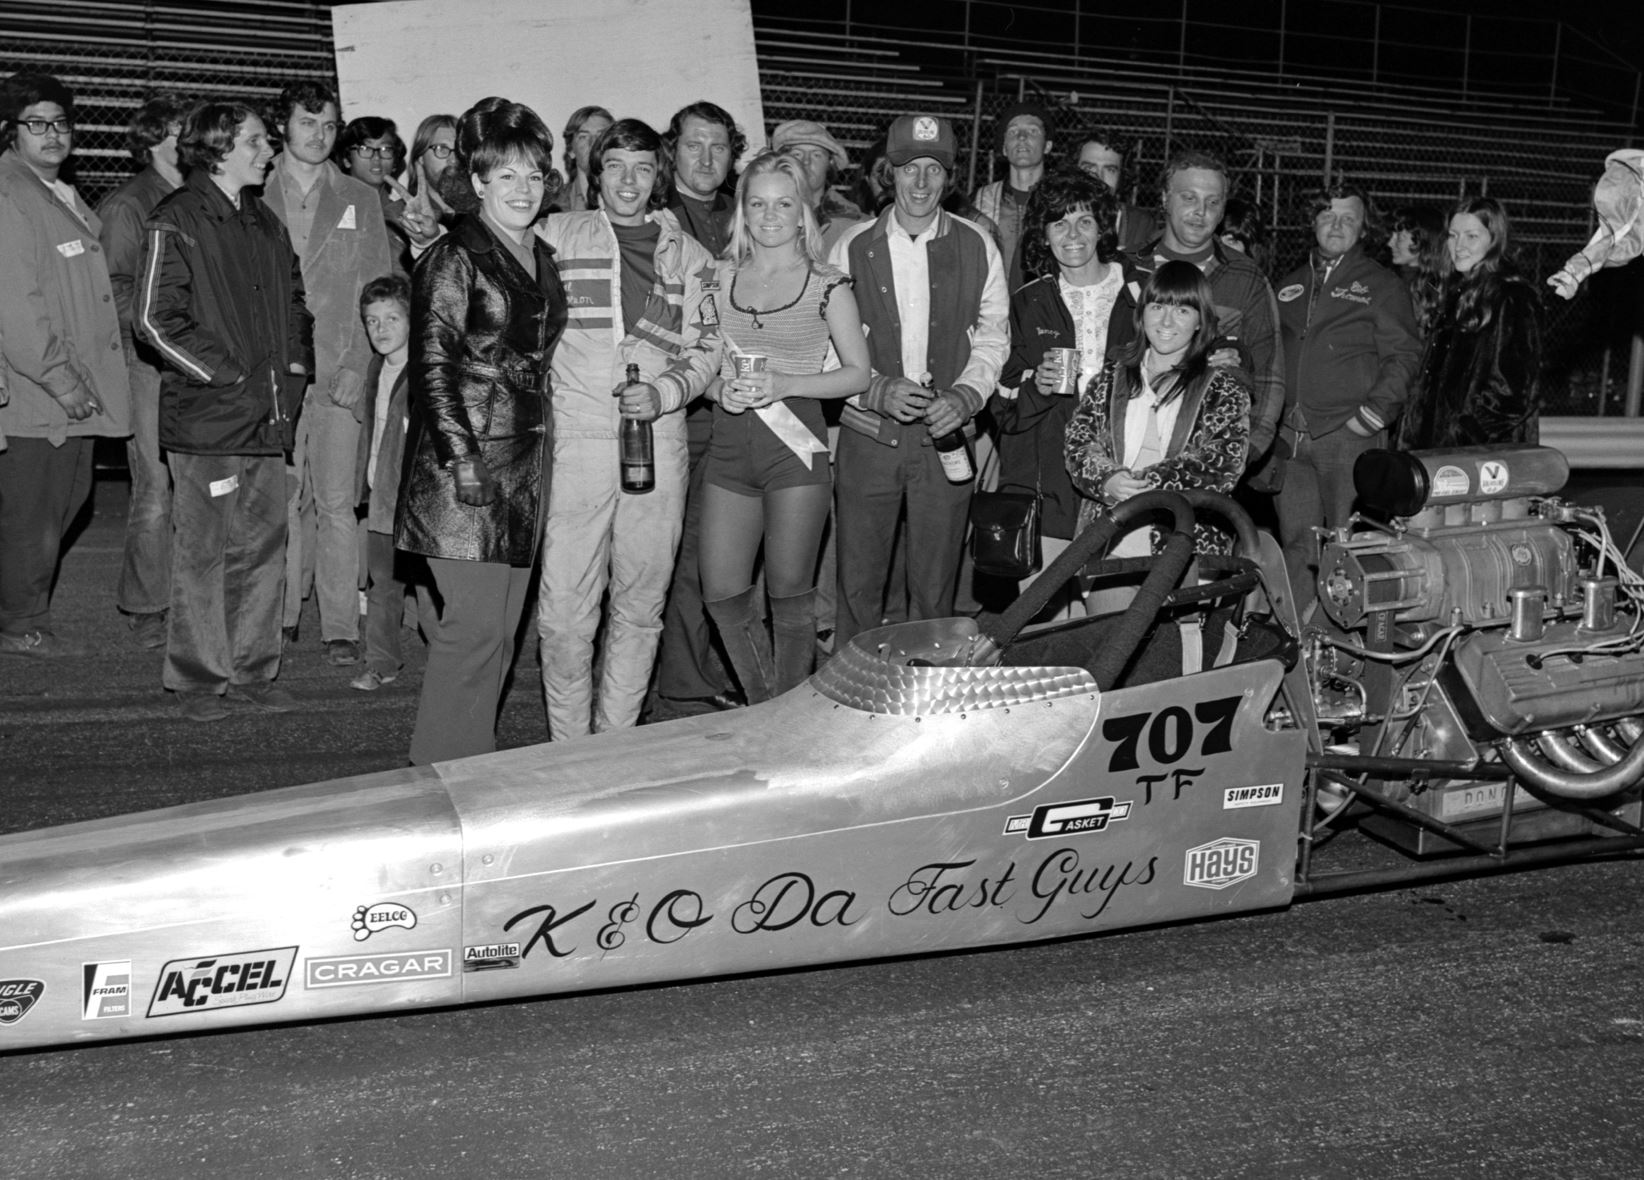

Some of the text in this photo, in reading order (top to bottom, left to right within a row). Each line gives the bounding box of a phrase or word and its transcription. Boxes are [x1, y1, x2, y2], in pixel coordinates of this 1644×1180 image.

[1103, 696, 1243, 772] 707
[1227, 786, 1280, 802] SIMPSON
[1189, 846, 1255, 882] Hays
[504, 848, 1159, 960] K & O Da Fast Guys
[370, 911, 407, 923] EELCO
[467, 945, 517, 959] Autolite
[315, 956, 443, 981] CRAGAR
[93, 986, 127, 995] FRAM
[157, 959, 283, 1007] ACCEL
